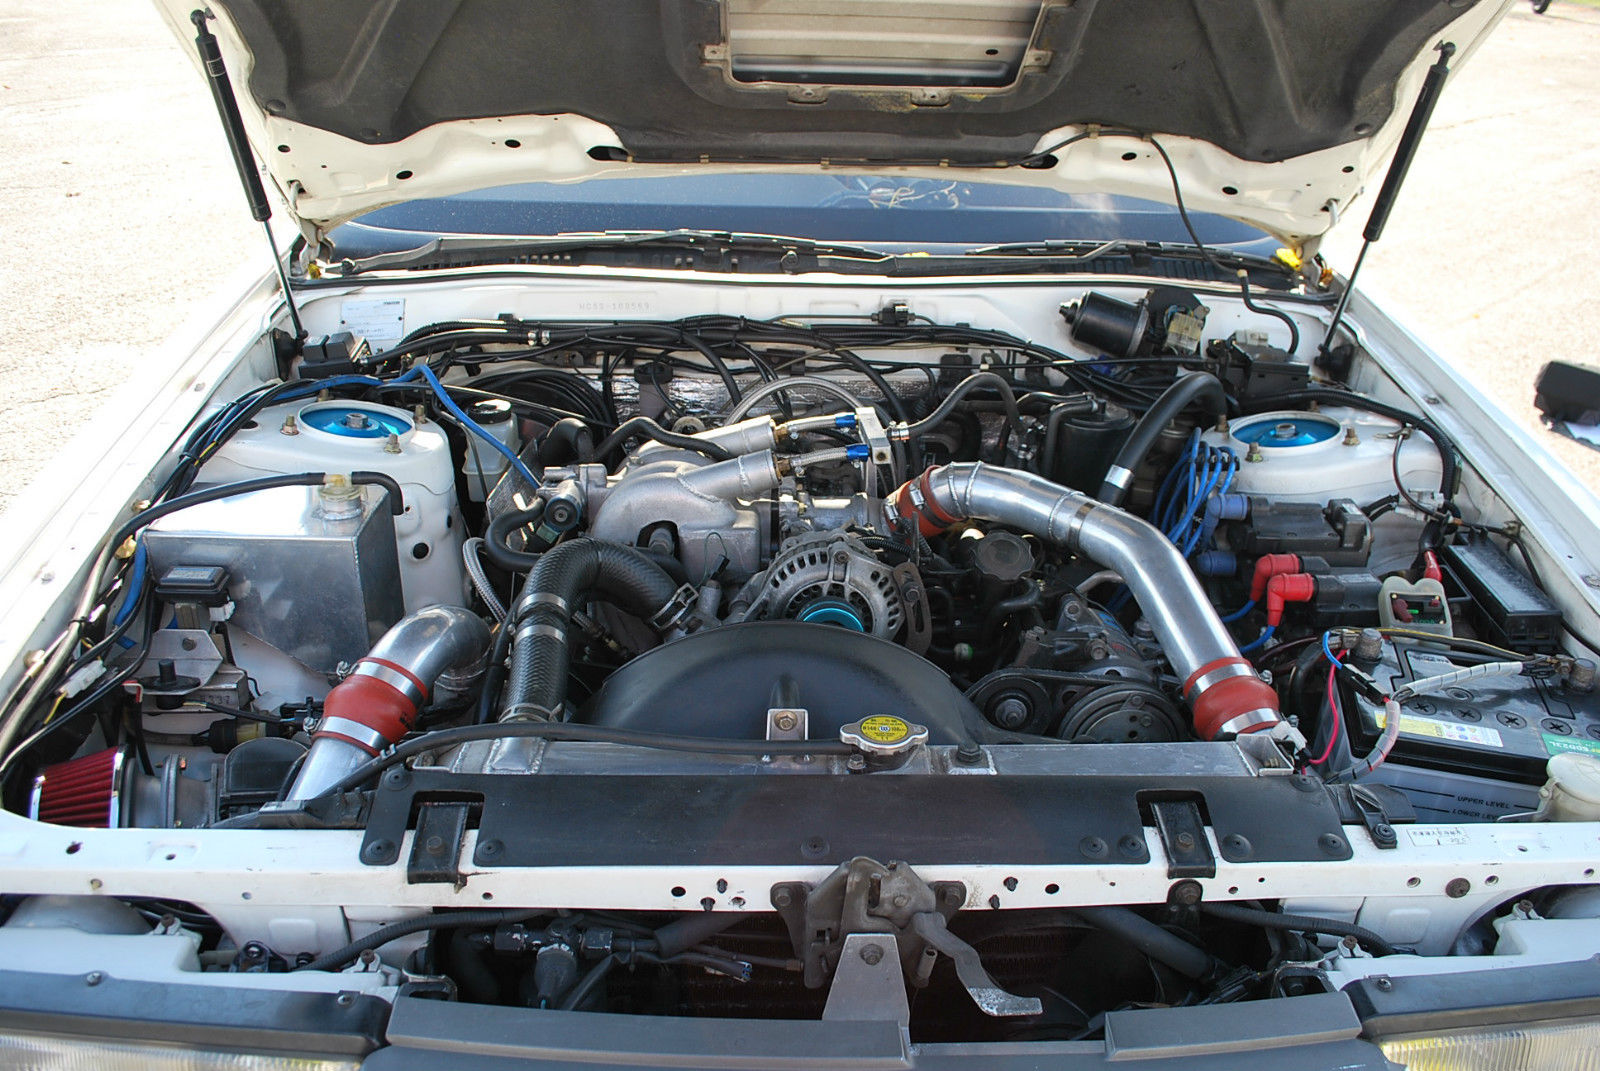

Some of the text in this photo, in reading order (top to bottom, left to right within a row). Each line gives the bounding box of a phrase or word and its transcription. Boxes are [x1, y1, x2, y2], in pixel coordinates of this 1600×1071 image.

[1457, 796, 1510, 809] UPPER LEVEL
[1452, 808, 1481, 818] LOWER
